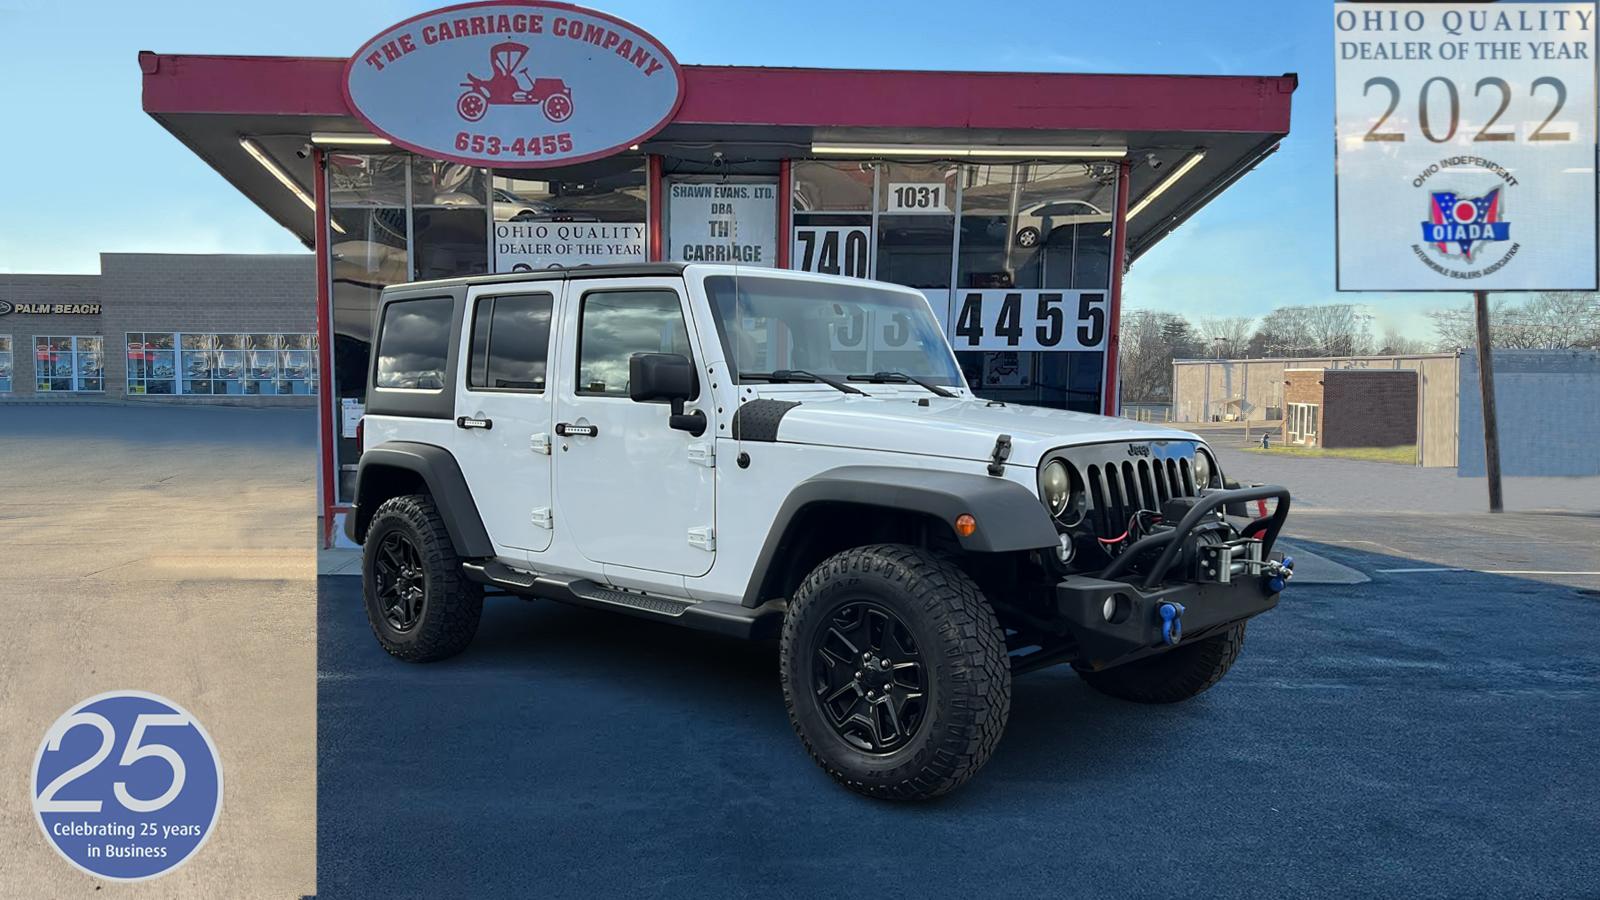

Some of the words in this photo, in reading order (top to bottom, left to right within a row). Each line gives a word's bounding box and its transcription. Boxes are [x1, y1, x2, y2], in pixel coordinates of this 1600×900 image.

[1336, 10, 1425, 31] OHIO
[1442, 10, 1593, 35] QUALITY
[365, 33, 417, 72] THE
[422, 14, 544, 45] CARRIAGE
[552, 17, 664, 77] COMPANY
[1340, 42, 1433, 60] DEALER
[1439, 42, 1469, 60] OF
[1475, 42, 1522, 60] THE
[1528, 42, 1589, 60] YEAR
[1363, 76, 1571, 143] 2022
[454, 132, 573, 157] 653-4455
[1412, 163, 1440, 188] OHIO
[1440, 155, 1519, 187] INDEPENDENT
[672, 185, 711, 198] SHAWN
[754, 187, 775, 199] LTD.
[895, 187, 940, 208] 1031
[497, 226, 548, 239] OHIO
[557, 226, 644, 241] QUALITY
[1432, 224, 1495, 240] OIADA
[500, 244, 552, 255] DEALER
[555, 244, 574, 255] OF
[576, 244, 603, 255] THE
[606, 244, 642, 255] YEAR
[682, 244, 762, 262] CARRIAGE
[796, 230, 868, 280] 740
[1449, 270, 1482, 279] DEALERS
[1482, 242, 1520, 276] ASSOCIATION
[15, 304, 51, 314] PALM
[956, 293, 1105, 347] 4455
[1127, 443, 1150, 458] Jeep
